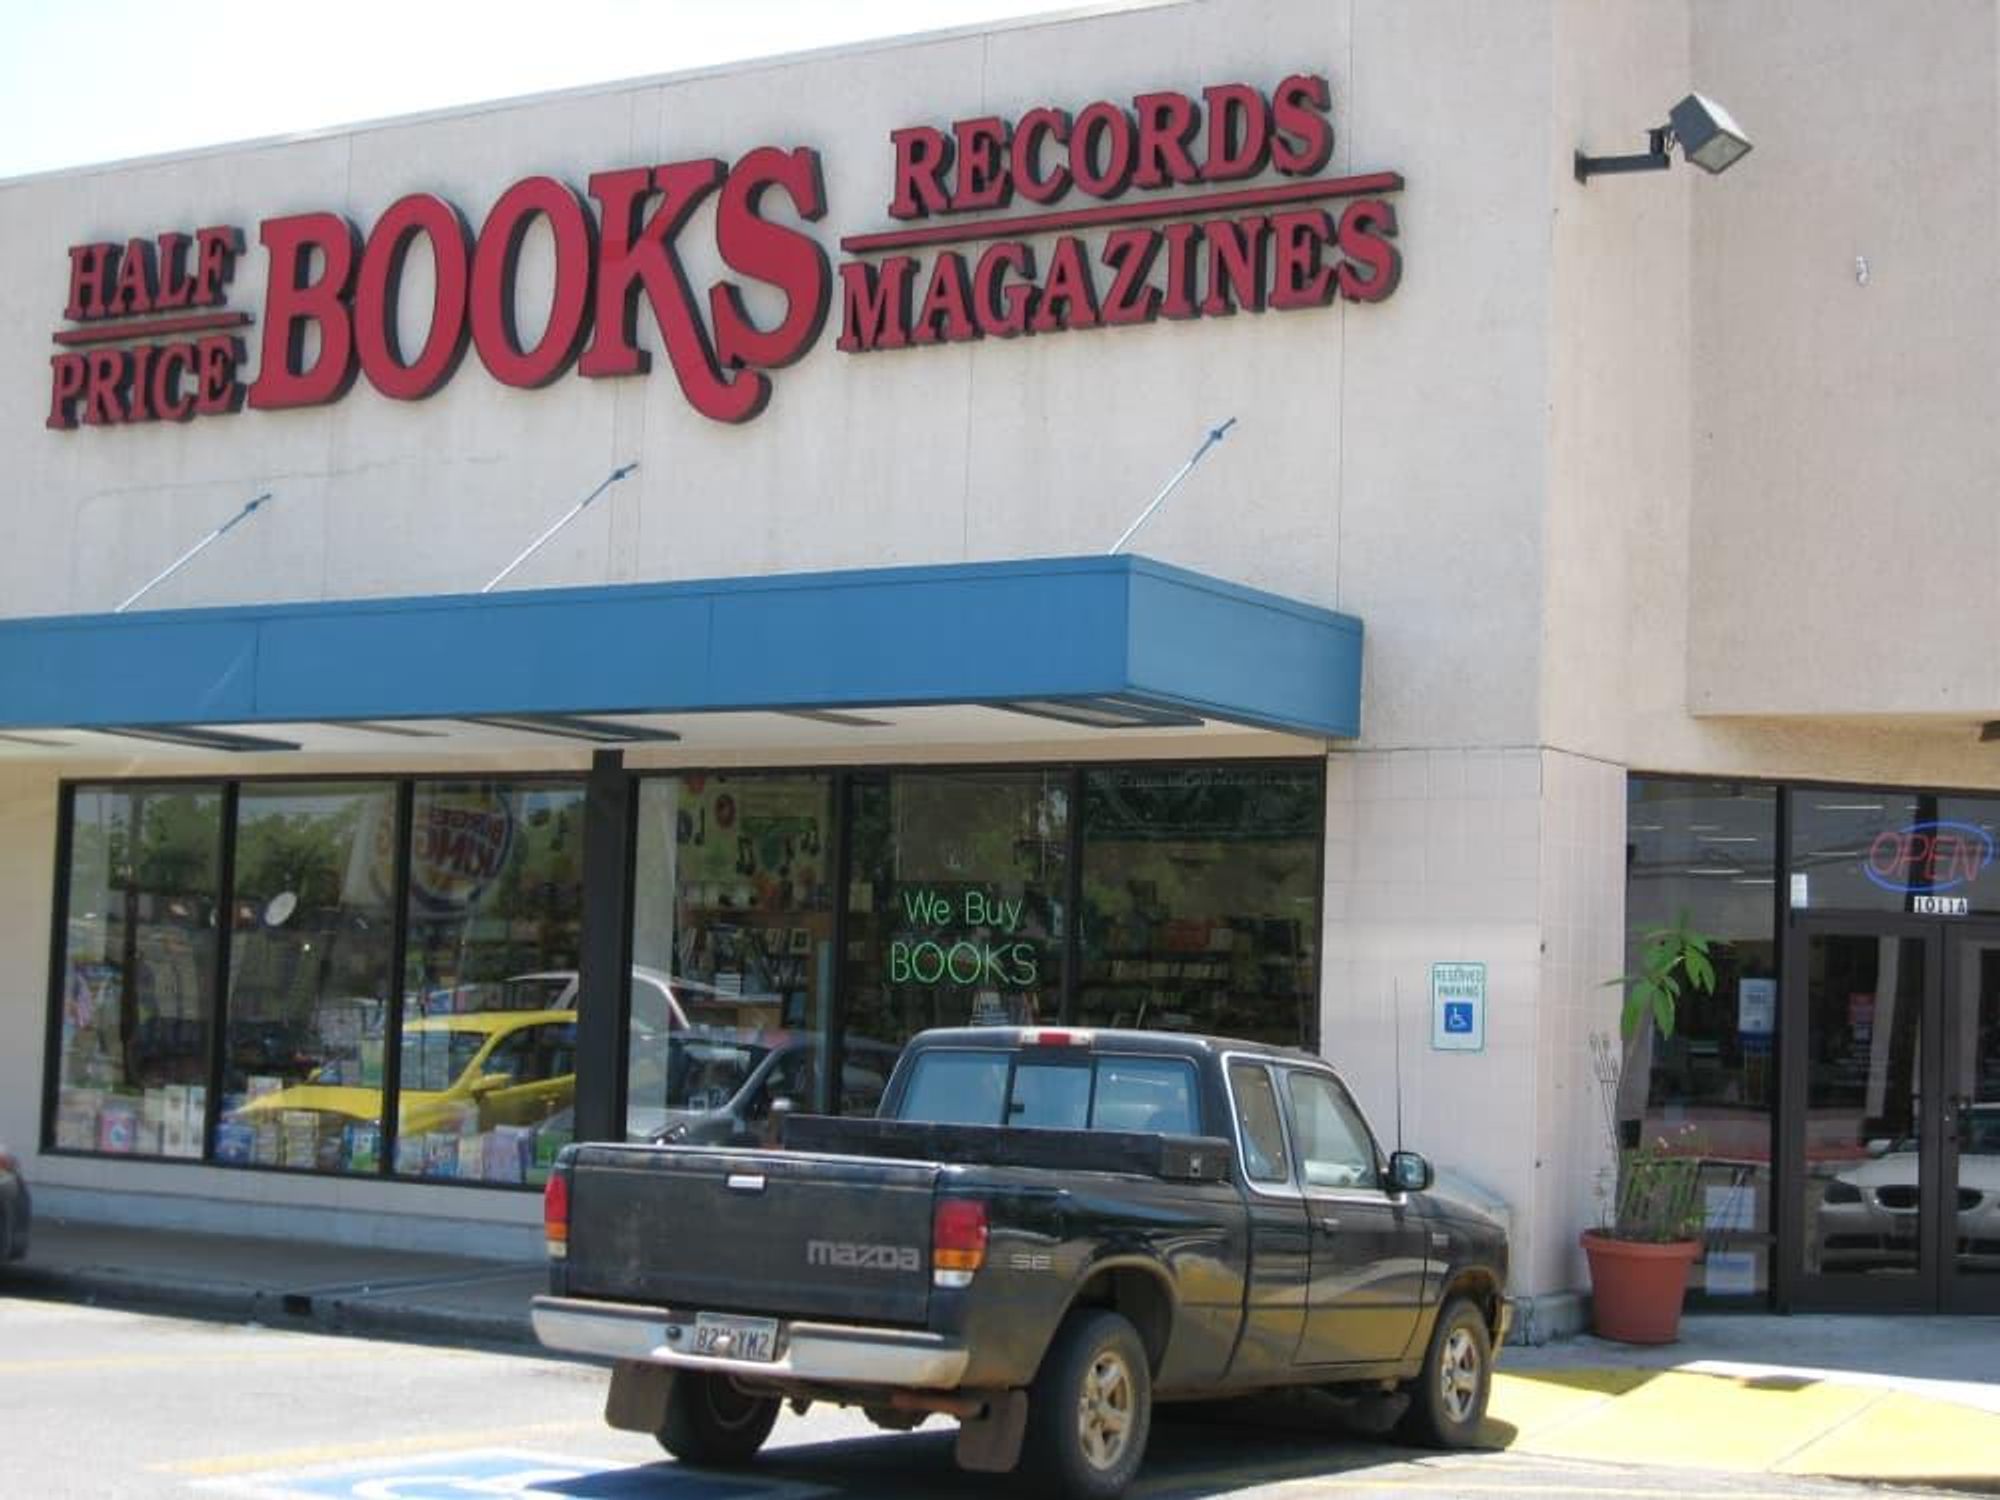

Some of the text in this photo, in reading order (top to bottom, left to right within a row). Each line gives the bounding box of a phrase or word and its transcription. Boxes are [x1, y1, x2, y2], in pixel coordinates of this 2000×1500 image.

[888, 74, 1334, 221] RECORDS
[64, 225, 246, 321] HALF
[248, 146, 832, 424] BOOKS
[837, 199, 1403, 353] MAGAZINES
[46, 334, 247, 430] PRICE
[1870, 832, 1985, 881] OPEN
[904, 890, 1023, 935] We Buy
[891, 942, 1037, 985] BOOKS
[807, 1240, 921, 1272] mazda
[1010, 1253, 1052, 1270] SE
